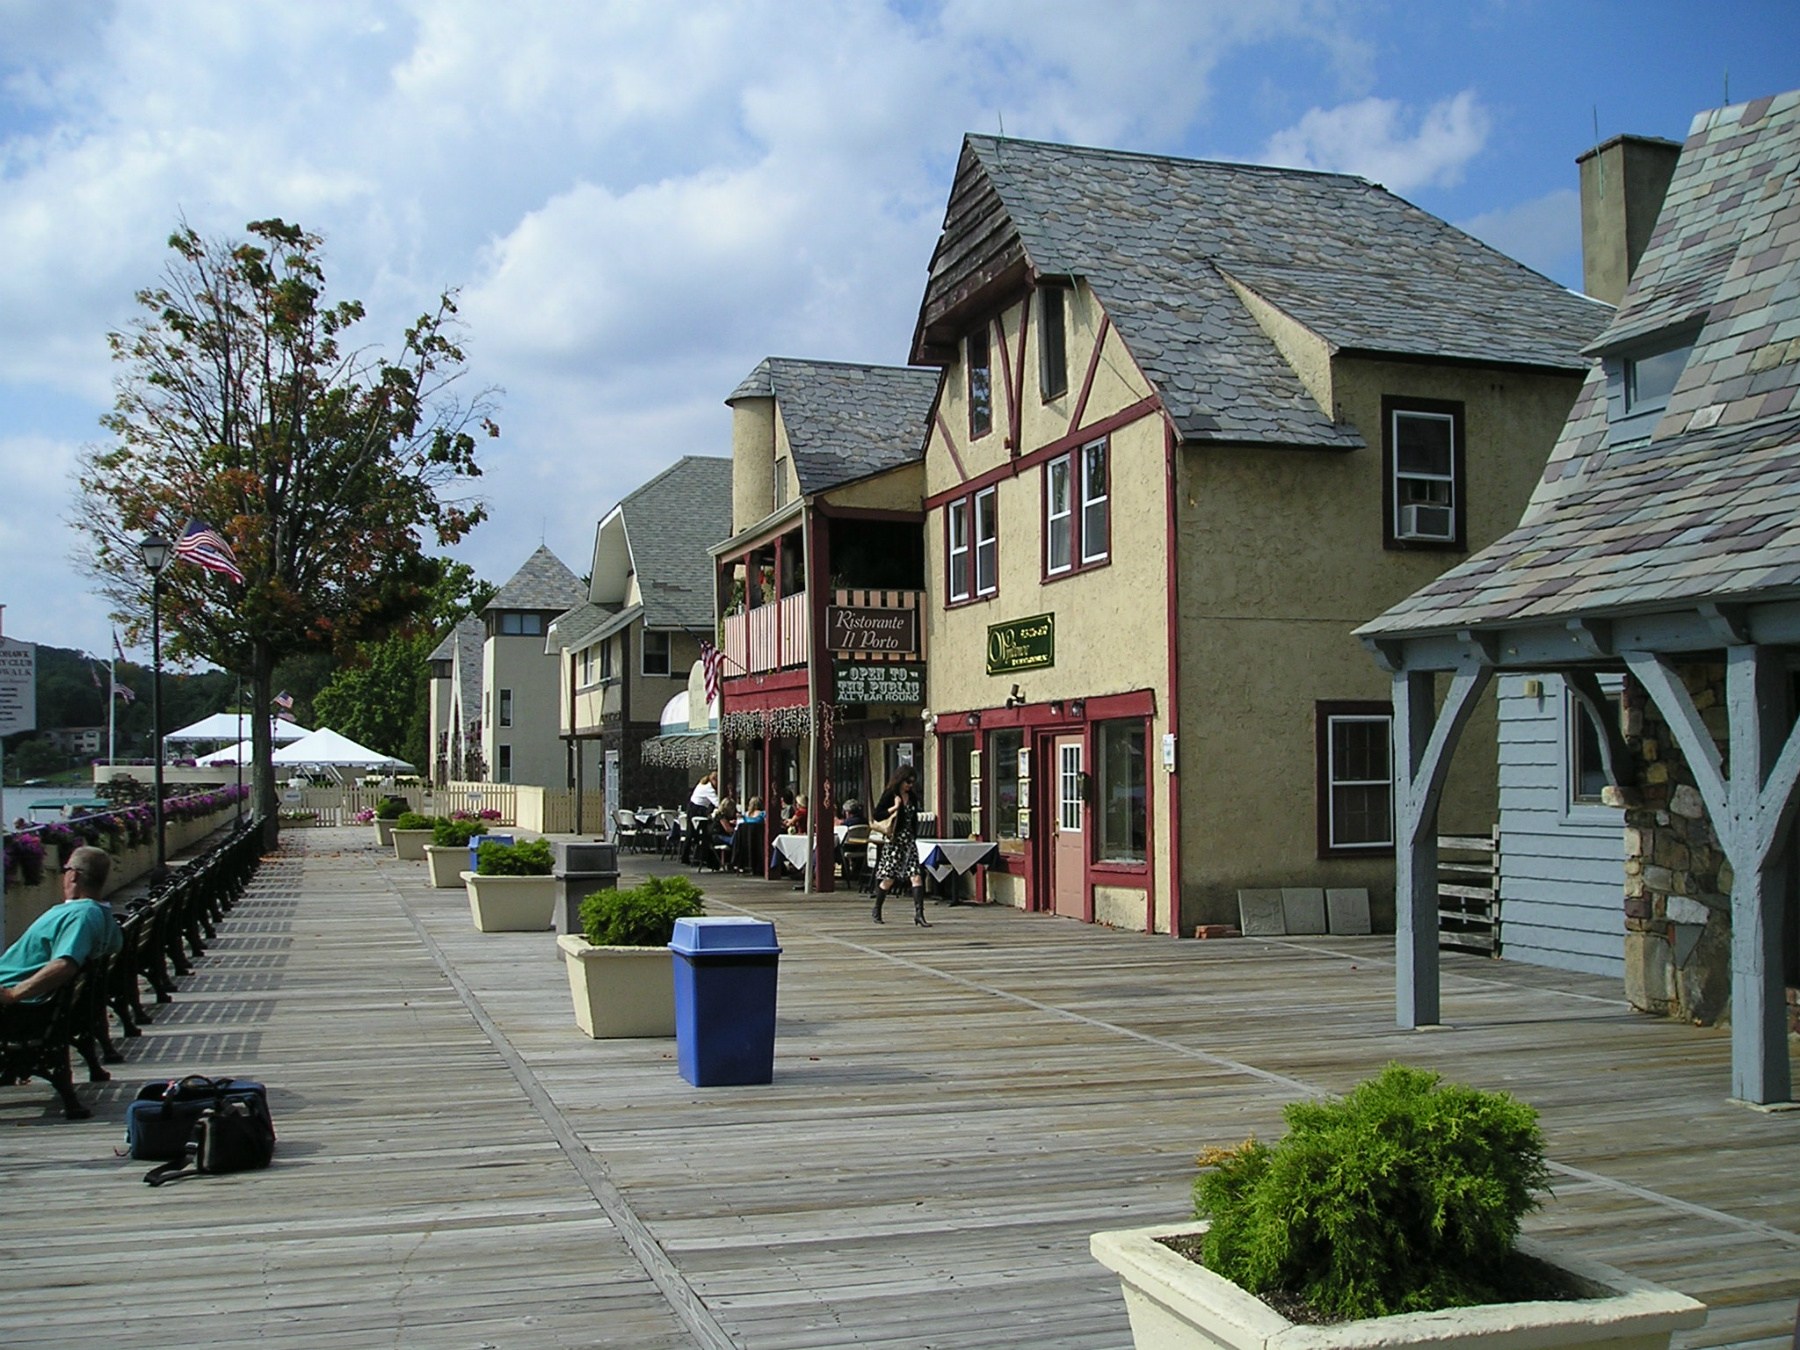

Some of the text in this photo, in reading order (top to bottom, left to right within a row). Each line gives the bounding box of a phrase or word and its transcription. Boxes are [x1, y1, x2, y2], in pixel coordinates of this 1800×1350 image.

[836, 610, 904, 629] Ristorante
[841, 630, 898, 648] Il Porto
[0, 668, 32, 676] WALK
[849, 667, 908, 681] OPEN TO
[837, 681, 920, 695] THE PUBLIC
[837, 693, 920, 701] ALL YEAR ROUND
